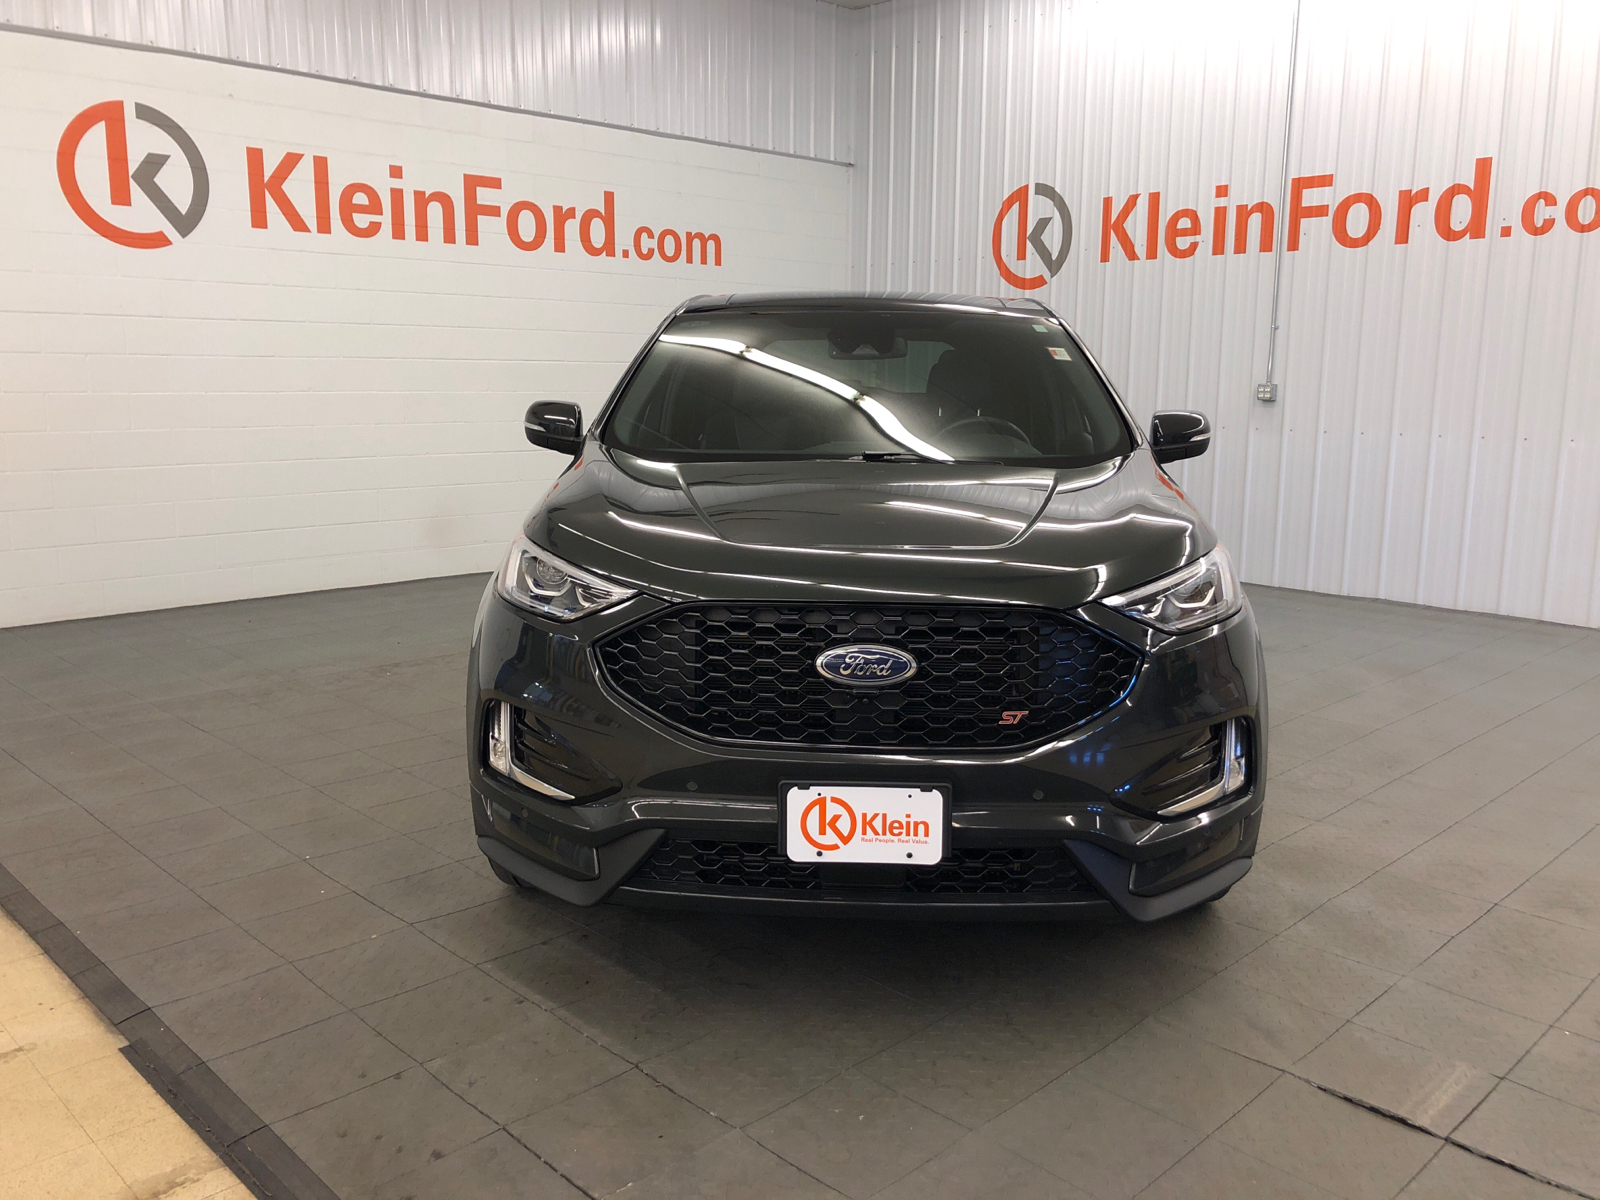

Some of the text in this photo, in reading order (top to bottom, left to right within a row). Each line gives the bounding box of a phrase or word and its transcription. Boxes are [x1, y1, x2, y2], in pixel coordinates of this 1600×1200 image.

[246, 146, 723, 268] KleinFord.com
[839, 653, 894, 677] Ford
[999, 710, 1029, 725] ST
[861, 812, 930, 838] Klein
